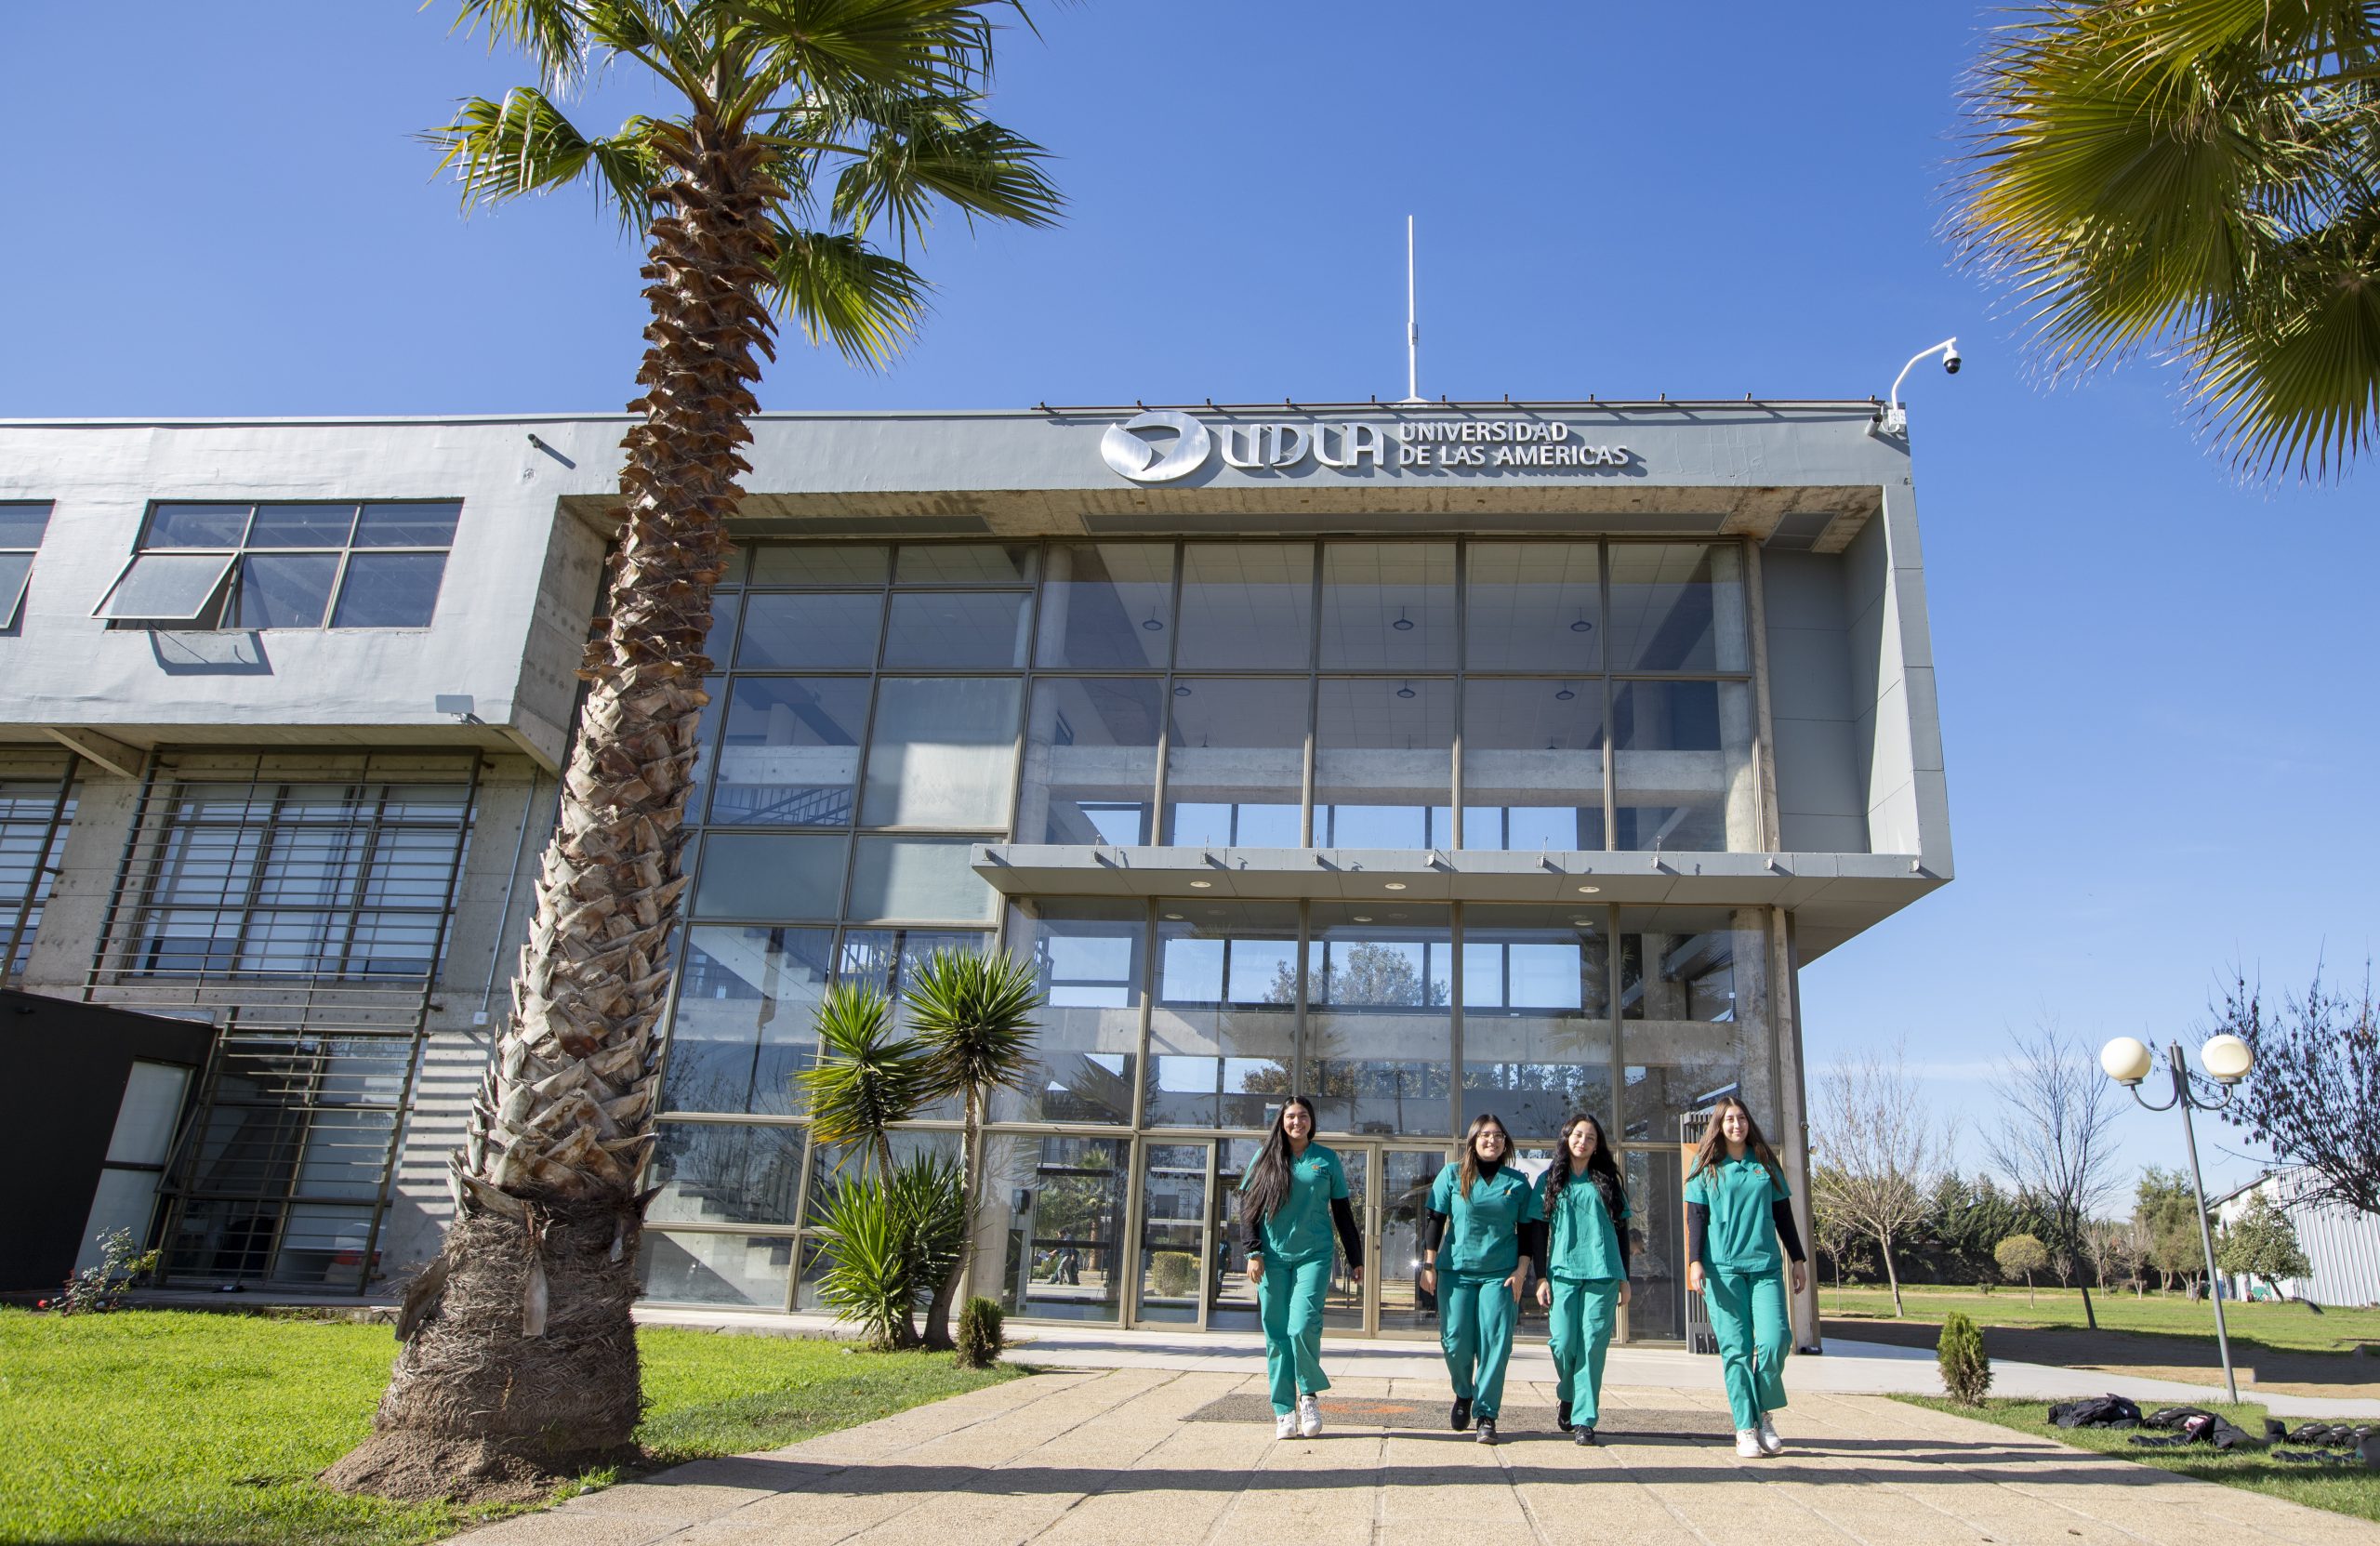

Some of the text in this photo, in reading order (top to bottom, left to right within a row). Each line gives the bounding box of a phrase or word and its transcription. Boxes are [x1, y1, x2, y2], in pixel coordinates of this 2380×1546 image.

[1399, 422, 1567, 442] UNIVERSIDAD
[1222, 423, 1383, 467] UDLA
[1399, 445, 1431, 465] DE
[1441, 445, 1486, 465] LAS
